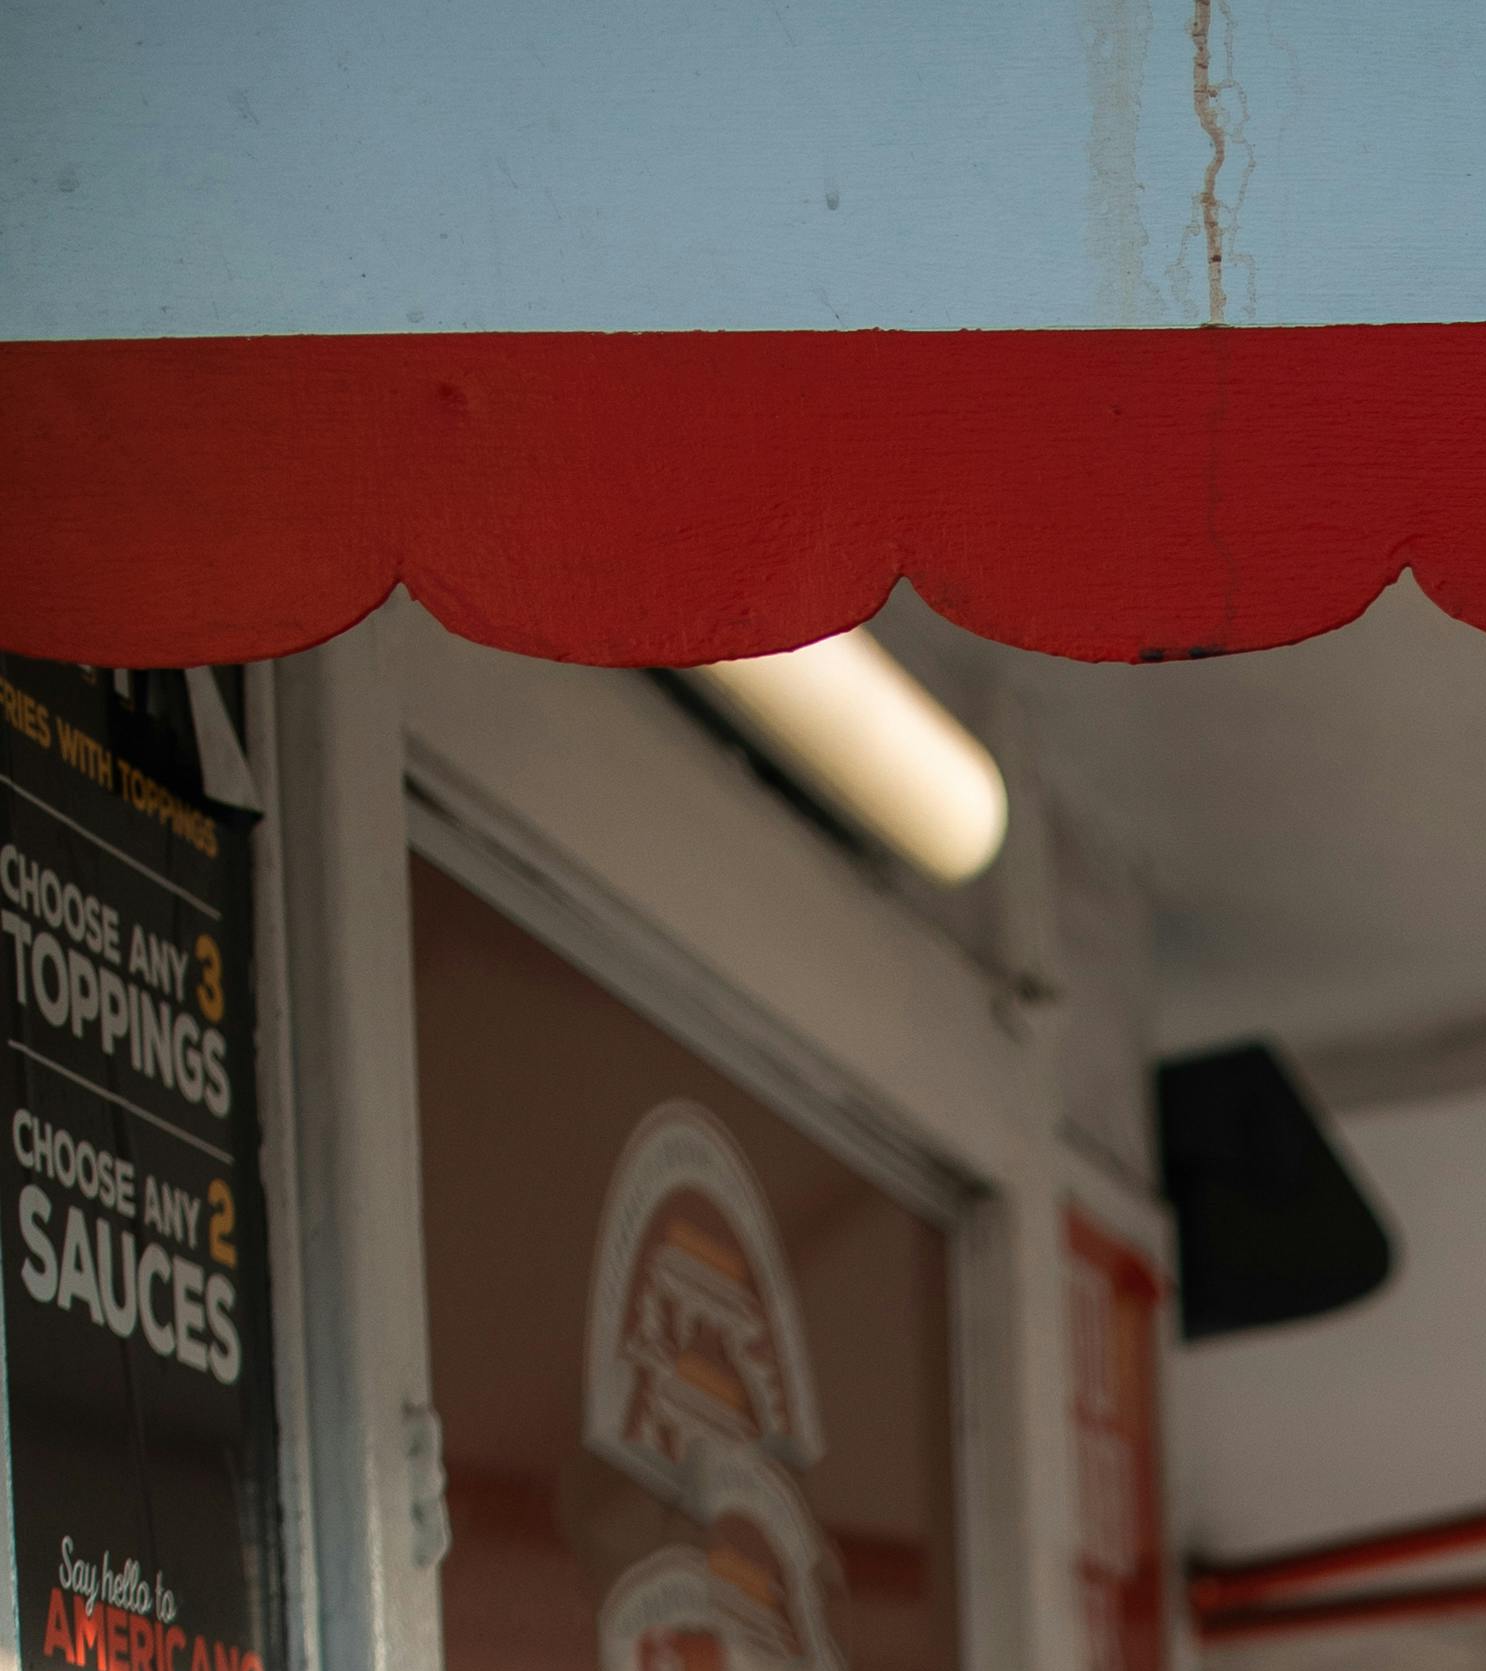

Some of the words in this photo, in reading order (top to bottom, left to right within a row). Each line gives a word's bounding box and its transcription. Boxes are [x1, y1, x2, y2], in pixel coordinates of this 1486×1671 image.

[56, 714, 112, 791] WITH
[0, 844, 121, 966] CHOOSE
[129, 922, 189, 1003] ANY
[196, 932, 225, 1024] 3
[1, 908, 231, 1119] TOPPINGS
[12, 1108, 136, 1219] CHOOSE
[144, 1174, 201, 1249] ANY
[208, 1177, 237, 1270] 2
[19, 1184, 243, 1385] SAUCES
[59, 1535, 98, 1616] Say
[101, 1550, 151, 1615] hello
[155, 1570, 176, 1623] to
